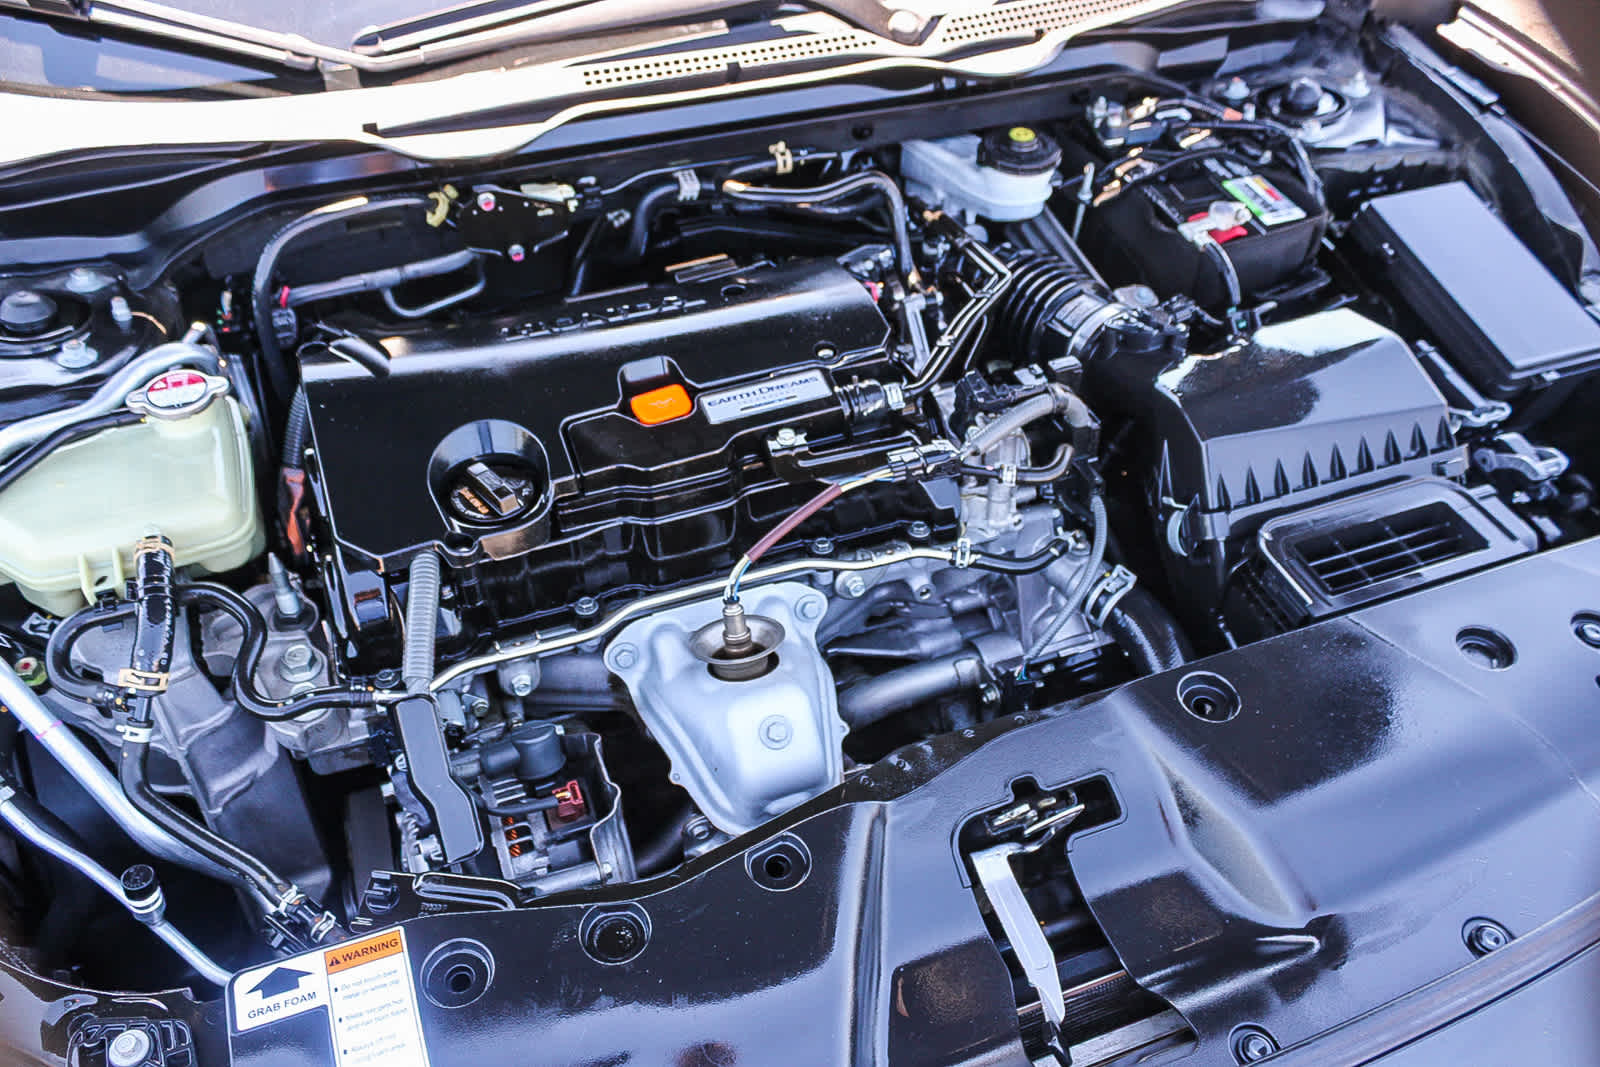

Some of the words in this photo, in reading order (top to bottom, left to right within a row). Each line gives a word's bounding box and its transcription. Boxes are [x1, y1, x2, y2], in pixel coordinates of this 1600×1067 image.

[341, 938, 400, 962] WARNING
[247, 1002, 281, 1019] GRAB
[284, 991, 317, 1009] FOAM
